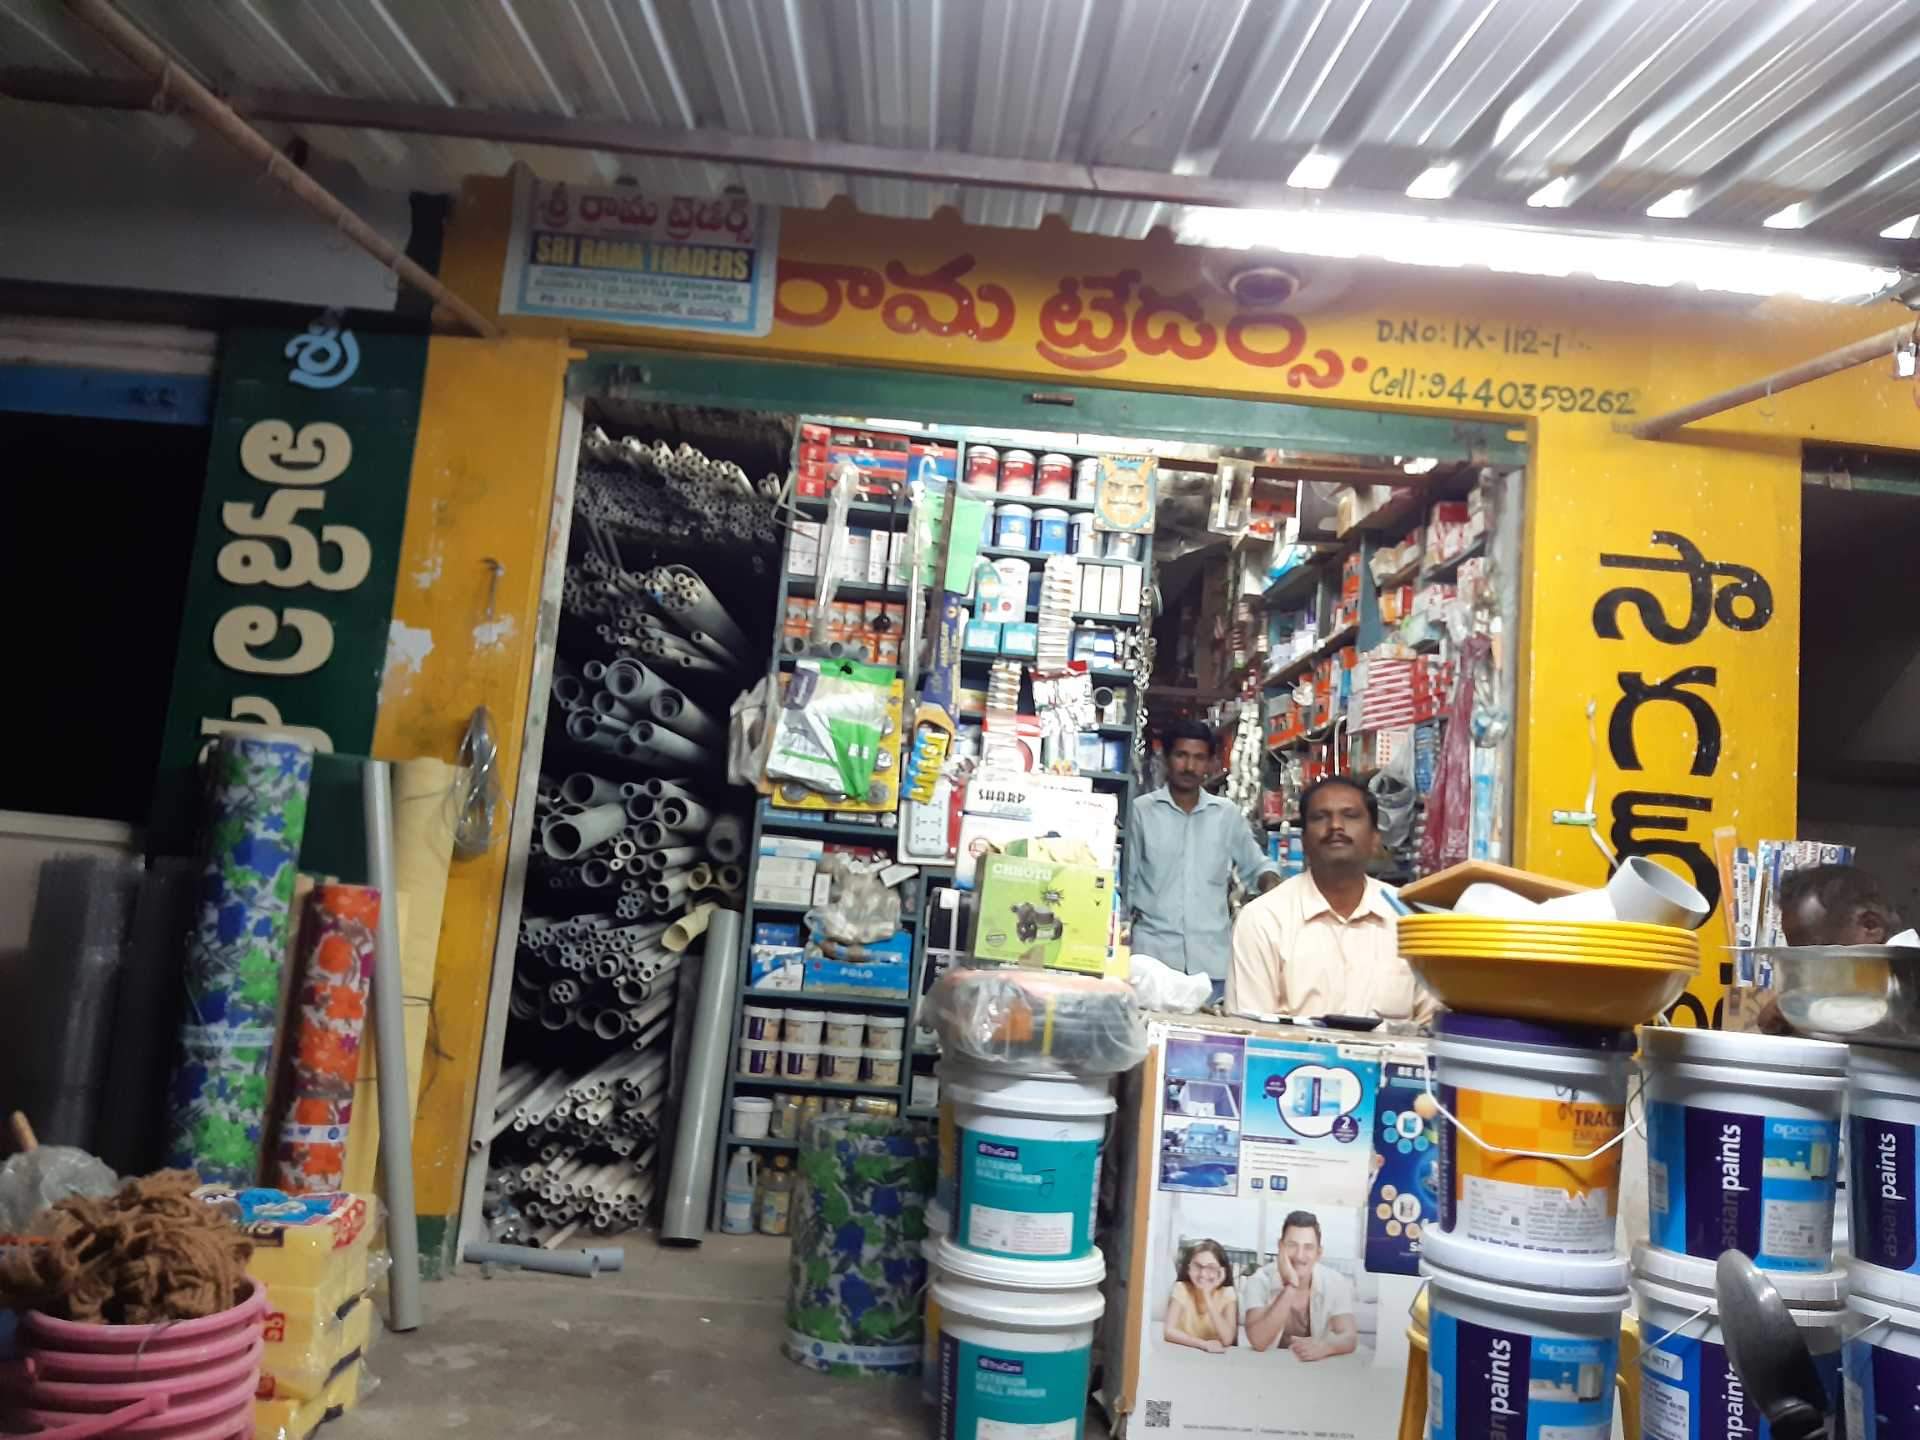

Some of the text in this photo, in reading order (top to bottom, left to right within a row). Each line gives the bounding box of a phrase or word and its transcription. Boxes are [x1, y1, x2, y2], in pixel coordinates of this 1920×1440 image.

[536, 236, 750, 281] SRI RAMA TRADERS
[774, 252, 1017, 343] రామ
[978, 788, 1026, 804] SHARP
[839, 967, 873, 979] POLO
[1004, 1173, 1042, 1185] PRIMER
